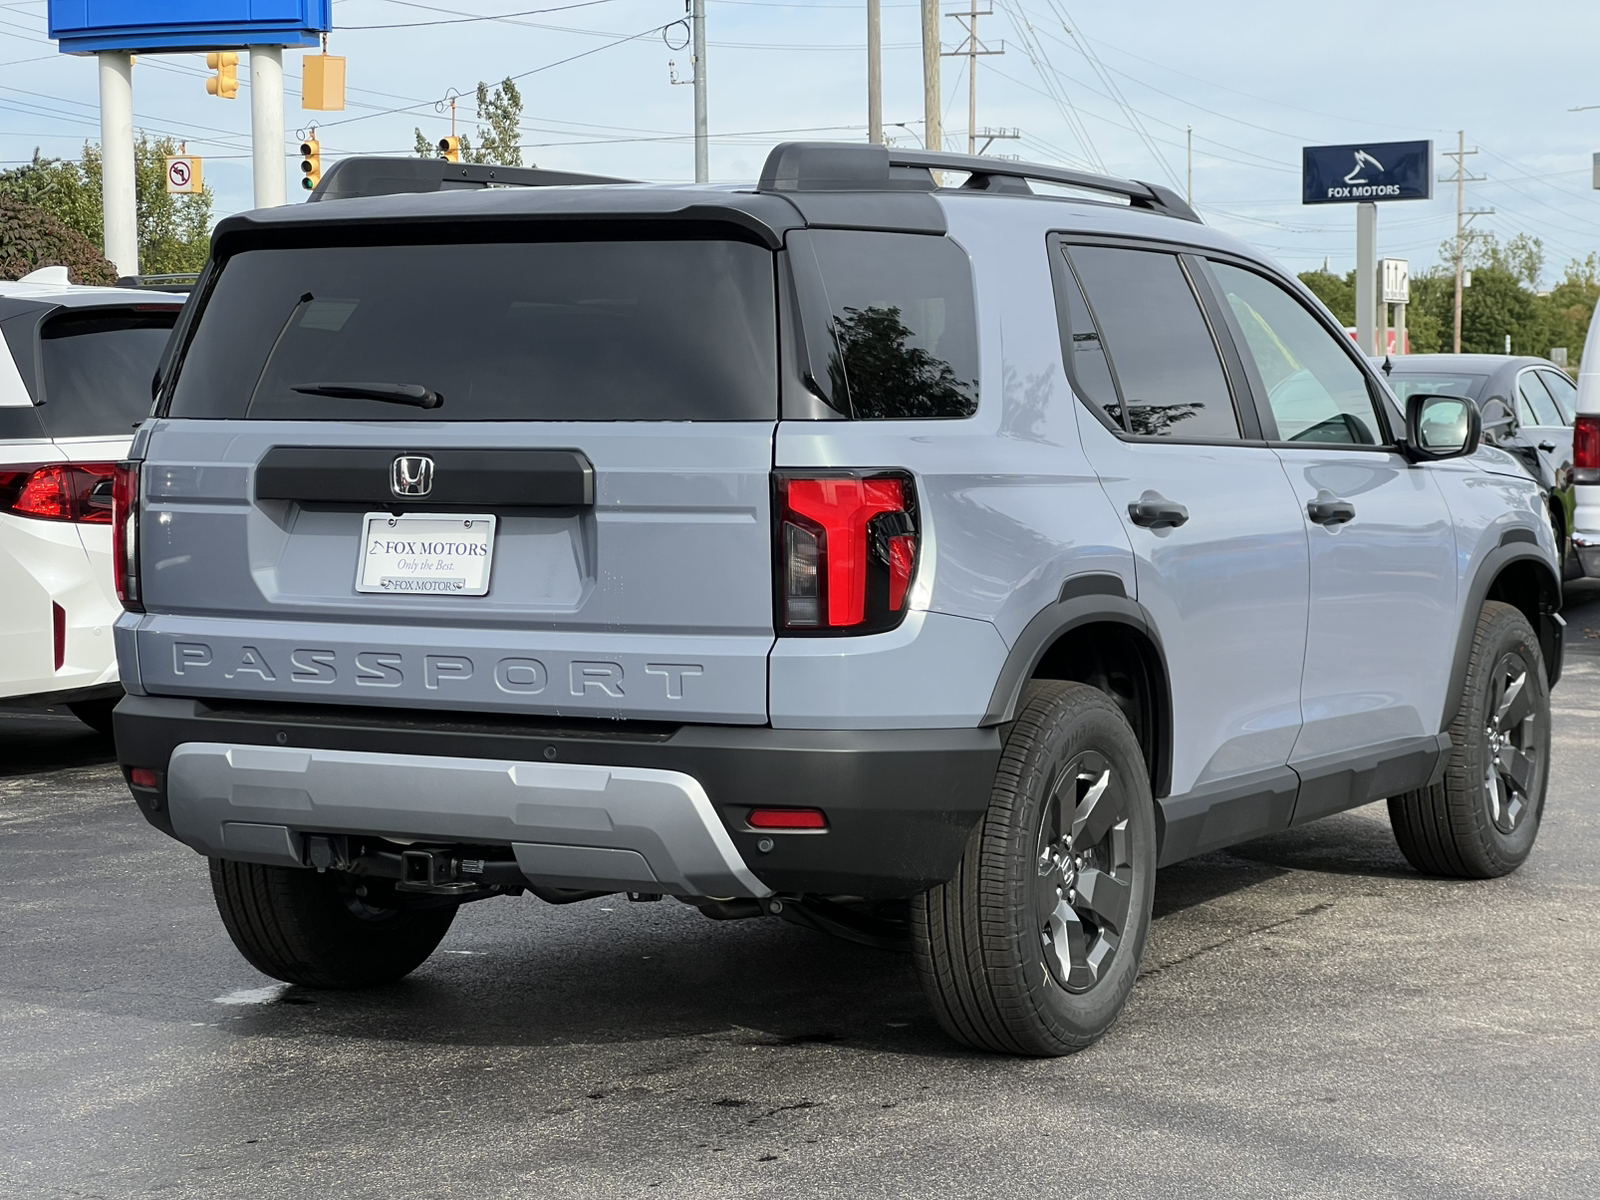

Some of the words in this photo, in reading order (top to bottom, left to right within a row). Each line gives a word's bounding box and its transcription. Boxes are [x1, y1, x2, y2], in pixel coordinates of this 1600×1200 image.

[1328, 187, 1350, 198] FOX
[1352, 185, 1400, 196] MOTORS
[385, 541, 416, 555] FOX
[419, 541, 488, 557] MOTORS
[397, 558, 418, 573] Only
[420, 559, 433, 570] the
[435, 559, 455, 571] Best.
[394, 580, 415, 590] FOX
[415, 581, 458, 592] MOTORS
[172, 641, 704, 700] PASSPORT
